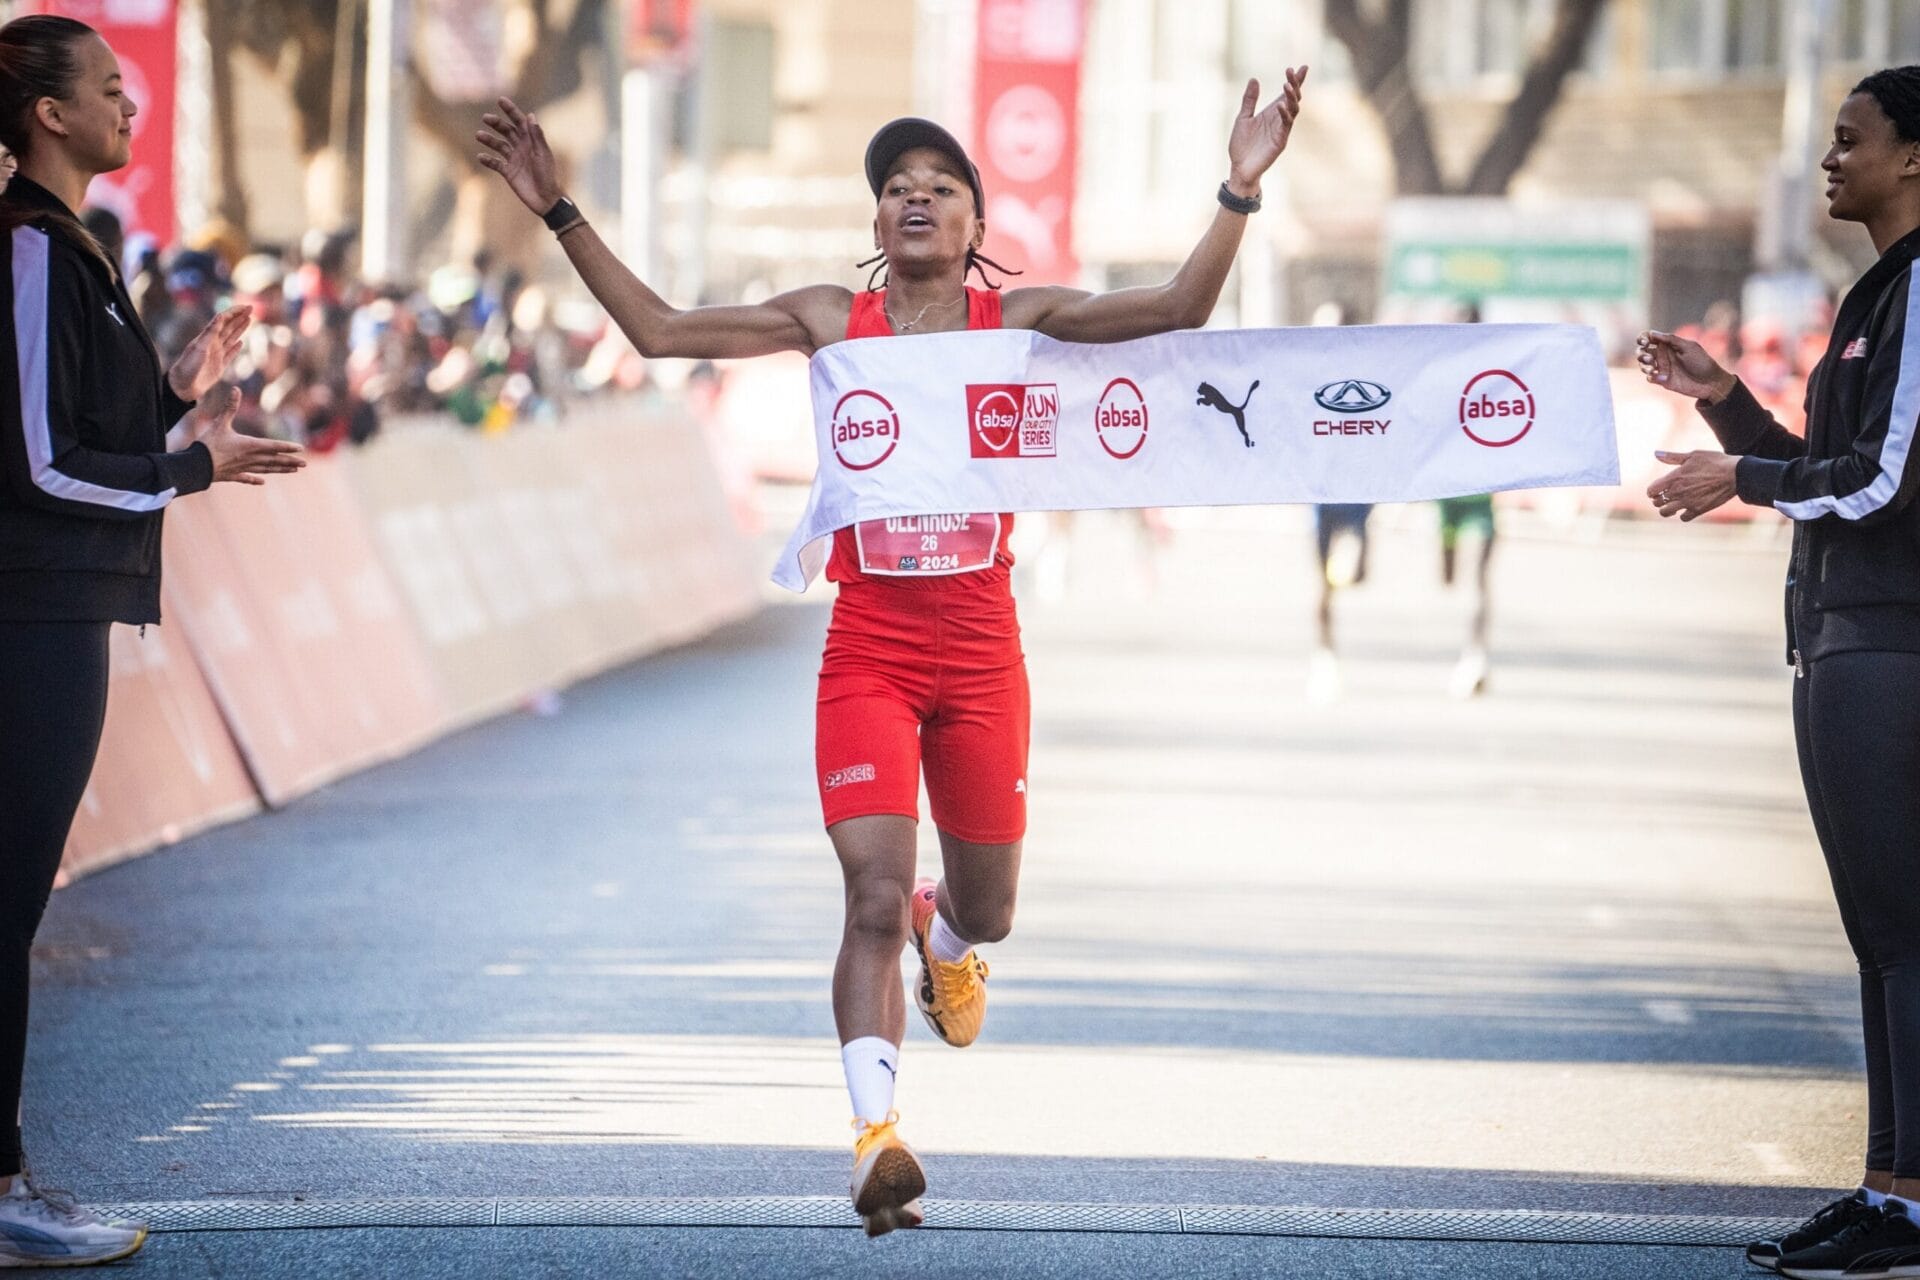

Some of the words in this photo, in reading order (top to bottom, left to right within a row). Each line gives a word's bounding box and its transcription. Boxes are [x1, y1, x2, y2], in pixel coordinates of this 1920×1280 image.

[1101, 402, 1141, 427] absa
[1468, 394, 1526, 418] absa
[982, 408, 1014, 428] absa
[1024, 420, 1038, 429] OUR
[837, 416, 890, 443] absa
[1313, 420, 1391, 435] CHERY
[921, 534, 938, 551] 26
[921, 554, 959, 570] 2024
